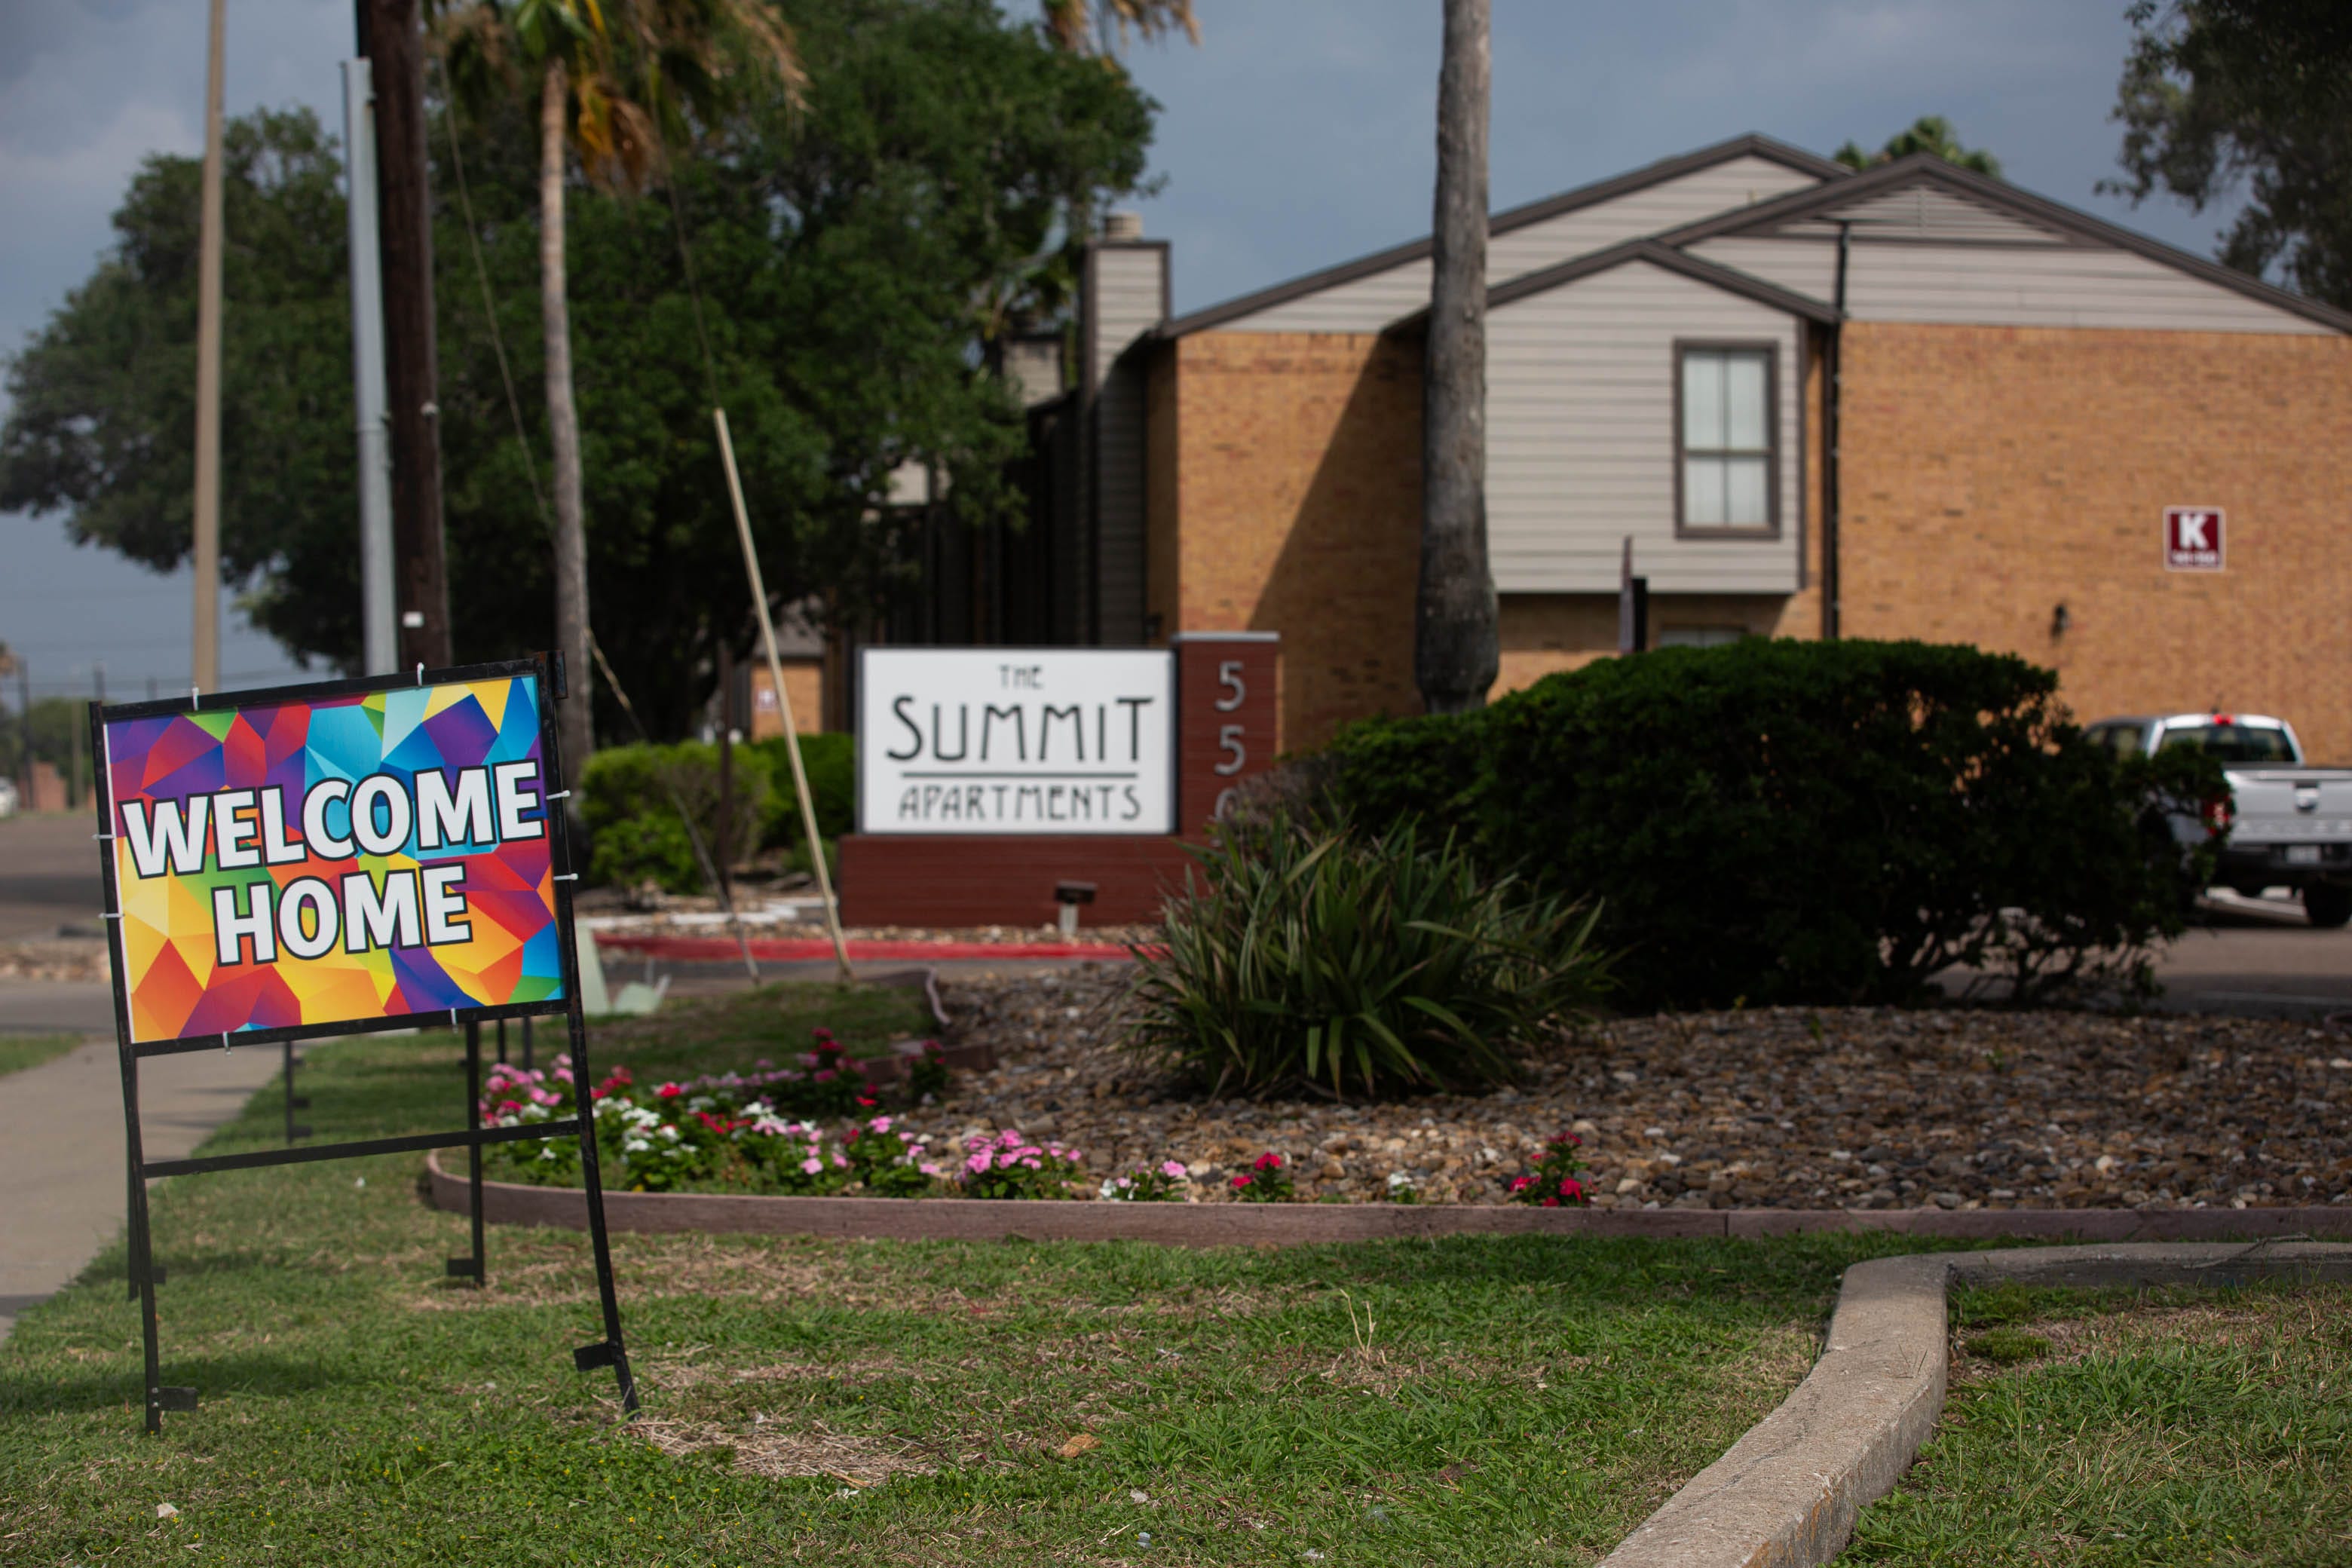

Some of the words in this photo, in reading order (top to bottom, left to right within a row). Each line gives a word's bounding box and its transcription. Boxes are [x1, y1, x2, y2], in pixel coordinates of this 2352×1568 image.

[2179, 513, 2210, 550] K
[998, 663, 1045, 690] THE
[885, 695, 1155, 762] SUMMIT
[118, 758, 547, 879] WELCOME
[898, 785, 1142, 822] APARTMENTS
[211, 862, 473, 967] HOME
